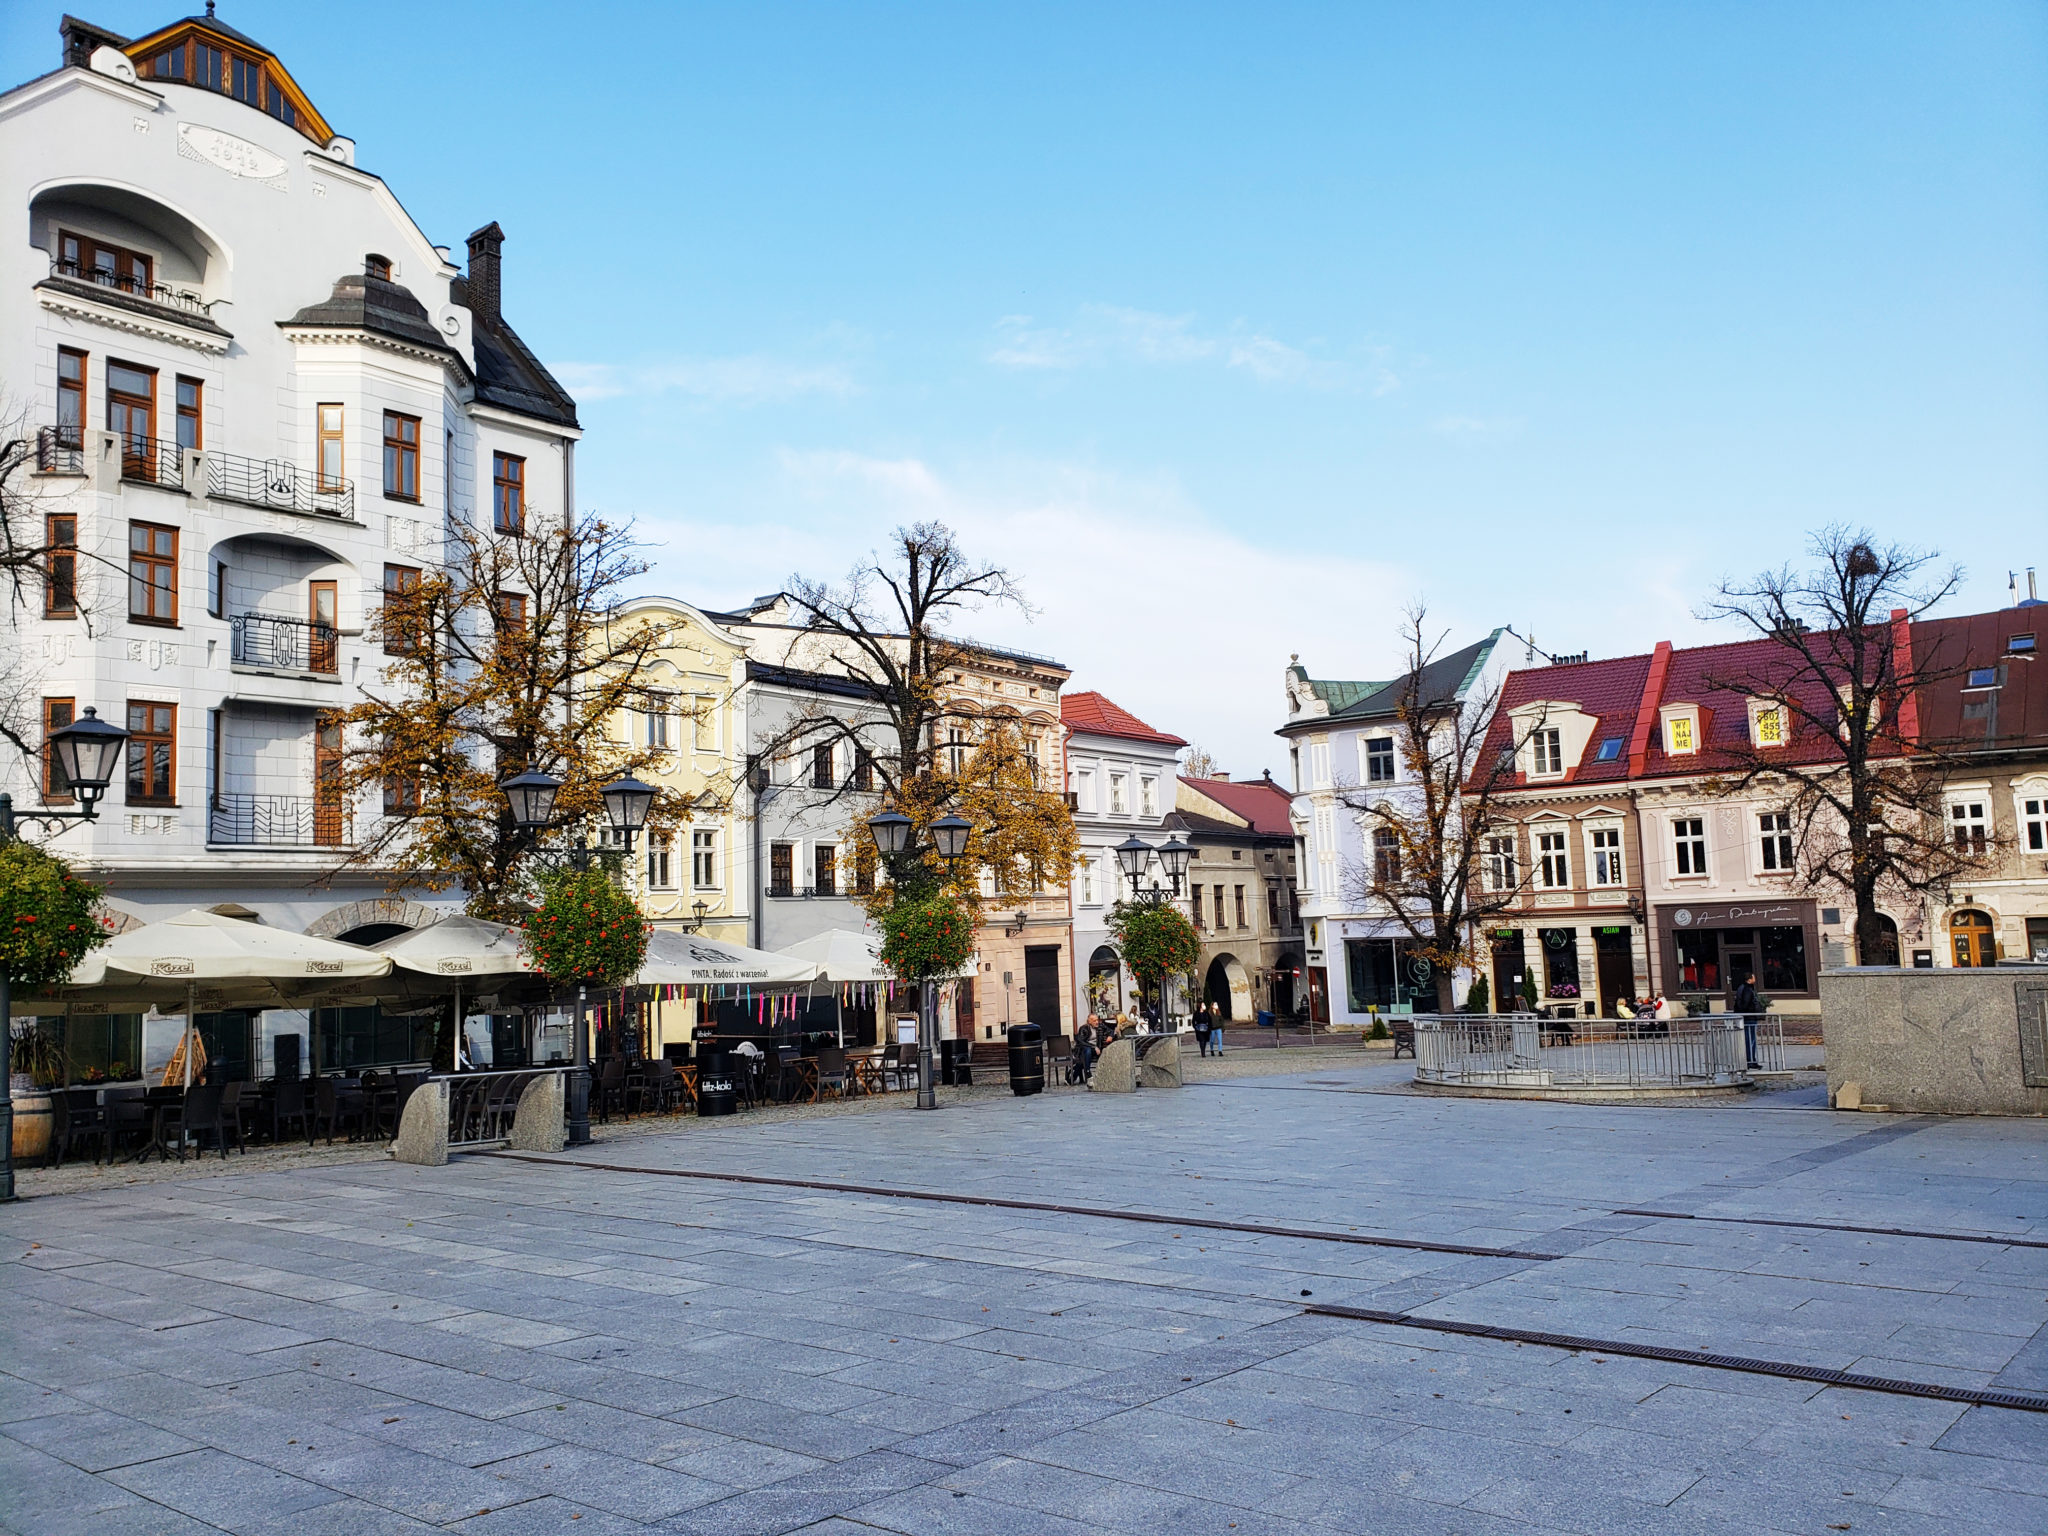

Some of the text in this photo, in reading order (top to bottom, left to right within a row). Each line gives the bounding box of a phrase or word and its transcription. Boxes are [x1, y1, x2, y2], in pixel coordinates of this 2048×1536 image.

[1674, 721, 1686, 729] WY
[1763, 722, 1780, 730] 455
[1675, 730, 1692, 738] NAJ
[1676, 739, 1688, 748] ME
[1612, 852, 1620, 883] TATTOO
[1602, 926, 1620, 934] ASIAN
[1633, 927, 1643, 935] 18
[151, 962, 195, 975] Kozel
[305, 961, 344, 973] Kozel
[437, 961, 473, 973] Kozel
[713, 968, 735, 979] Radość
[740, 969, 770, 979] warzenia!
[702, 1080, 732, 1092] fritz-kola
